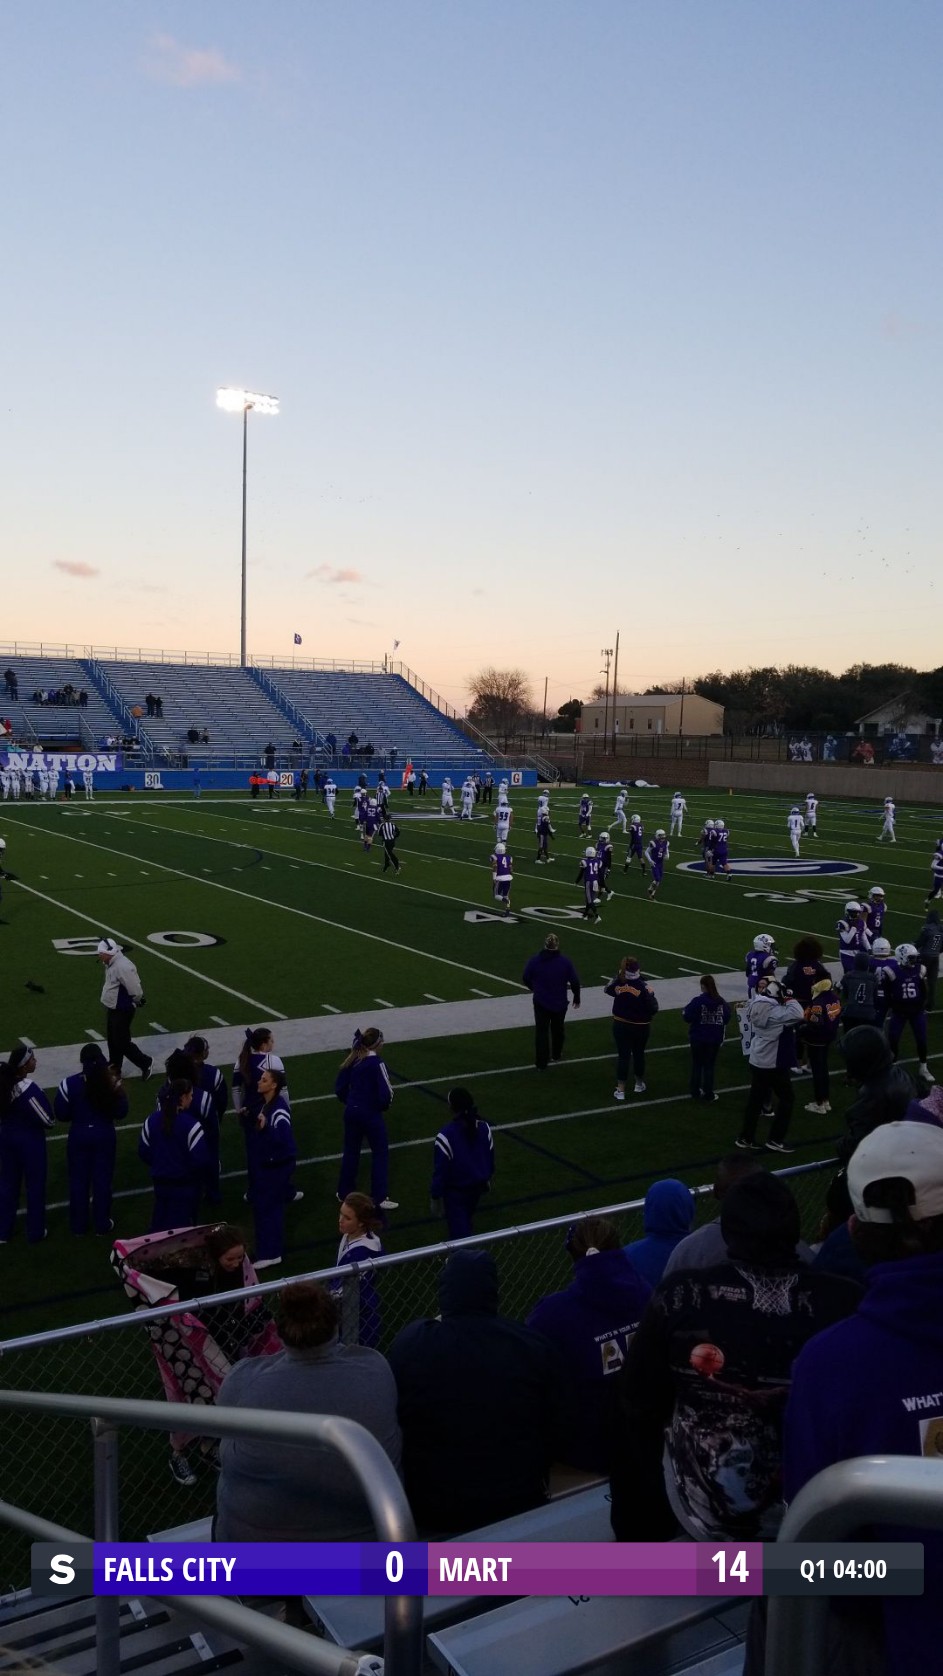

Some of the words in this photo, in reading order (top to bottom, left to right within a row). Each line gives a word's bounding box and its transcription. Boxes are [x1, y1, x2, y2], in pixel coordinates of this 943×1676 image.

[4, 752, 117, 771] NATION
[146, 774, 159, 786] 30
[281, 774, 293, 786] 20
[367, 808, 376, 817] 52
[499, 812, 508, 821] 55
[718, 832, 728, 842] 72
[501, 857, 508, 868] 4
[589, 862, 599, 874] 14
[855, 983, 866, 1003] 4
[902, 982, 917, 999] 16
